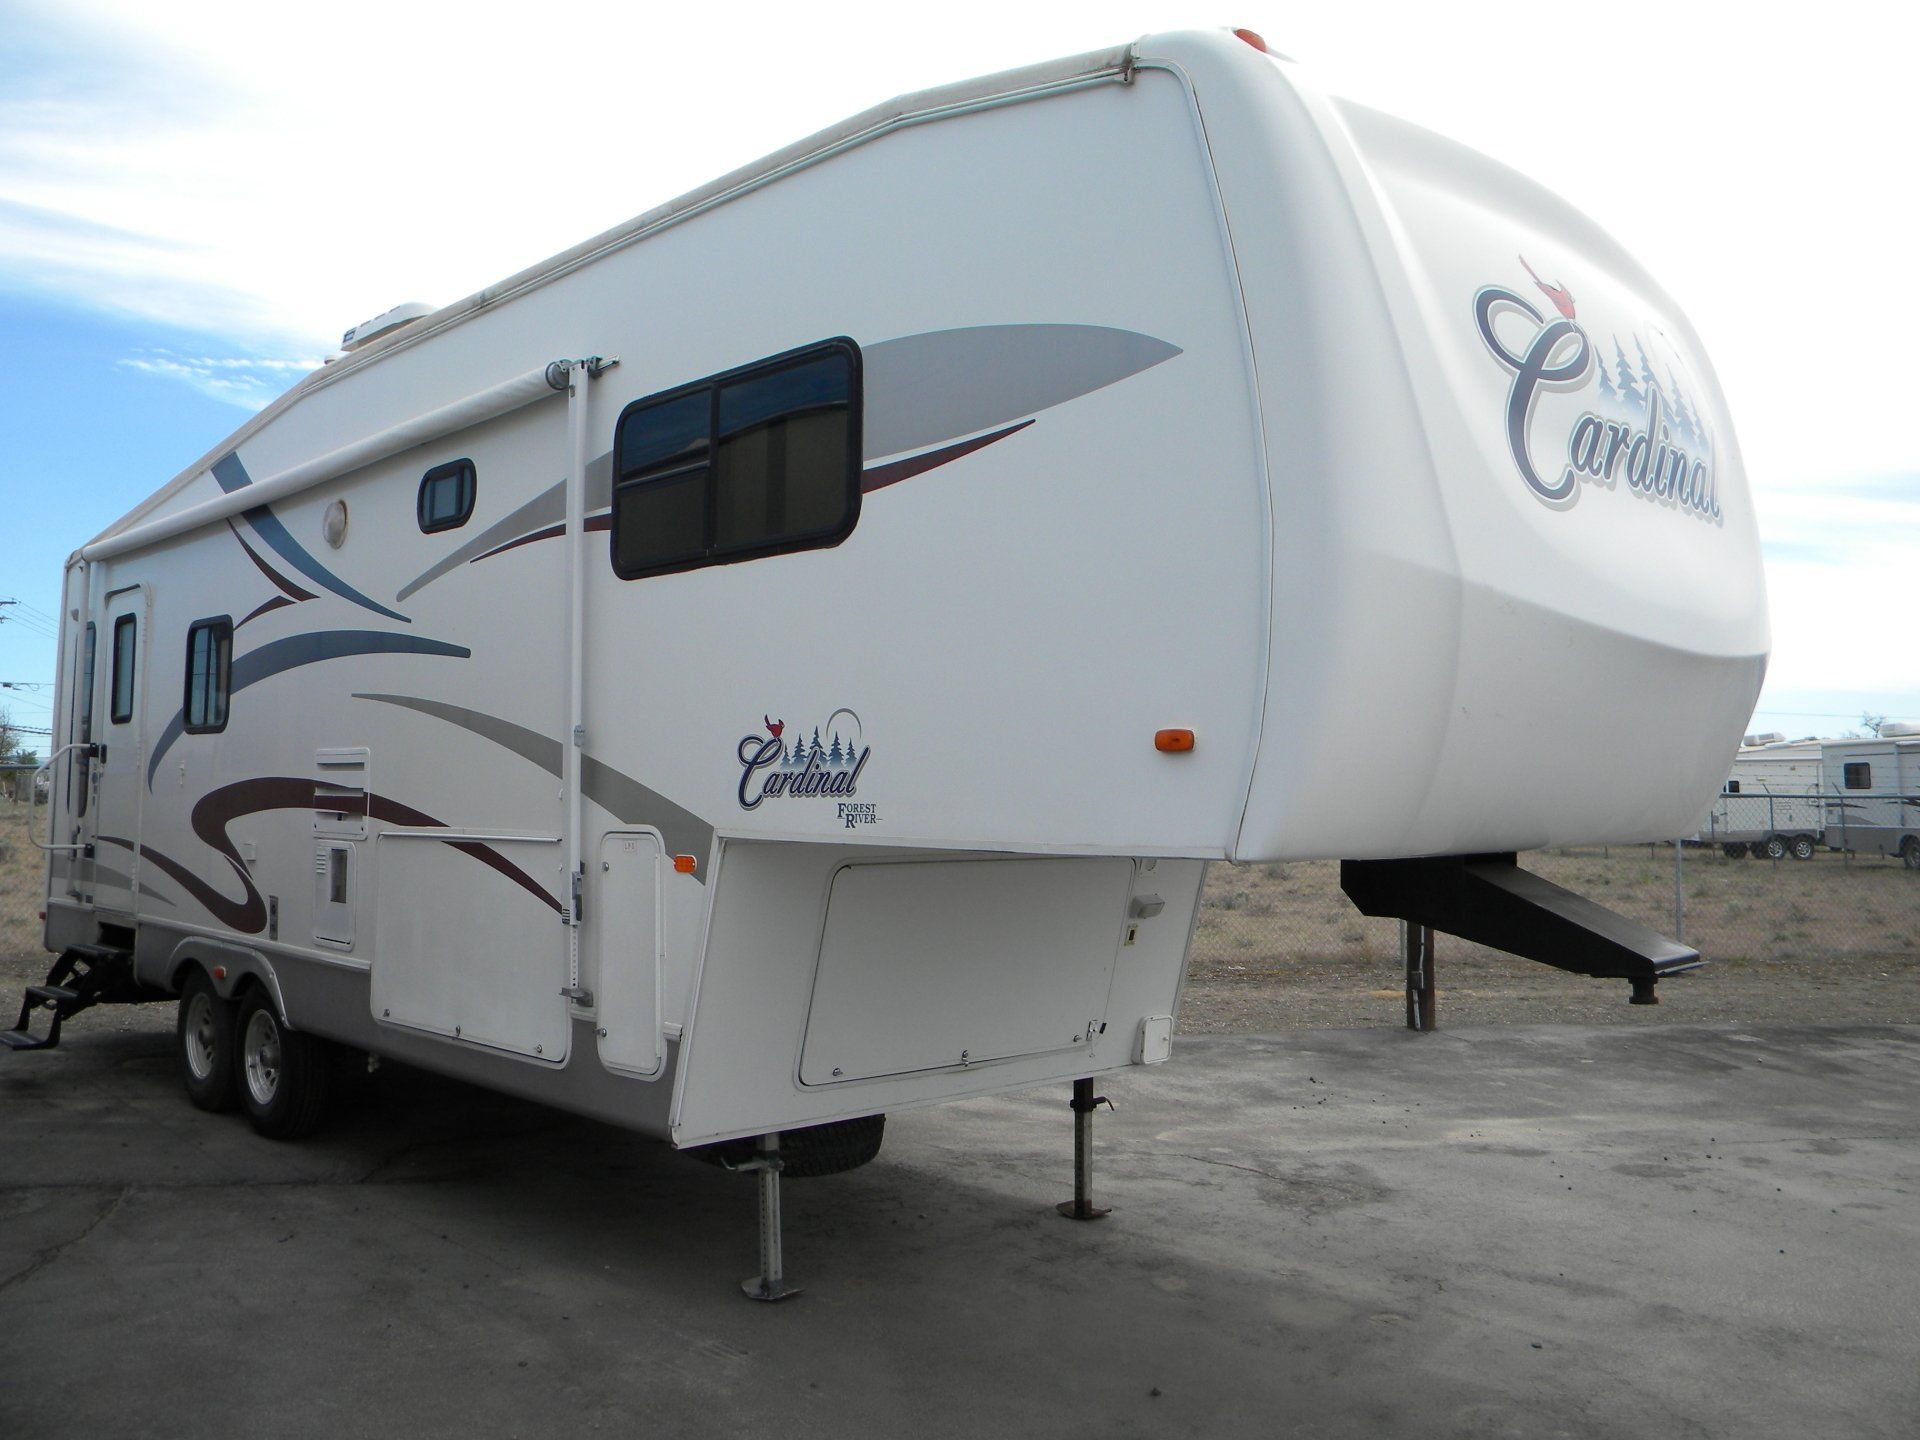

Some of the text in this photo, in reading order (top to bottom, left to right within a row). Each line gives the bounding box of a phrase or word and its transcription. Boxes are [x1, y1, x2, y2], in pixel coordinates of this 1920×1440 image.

[1473, 285, 1722, 526] Cardinal
[738, 735, 871, 811] Cardinal
[837, 803, 877, 818] FOREST
[845, 813, 877, 829] RIVER
